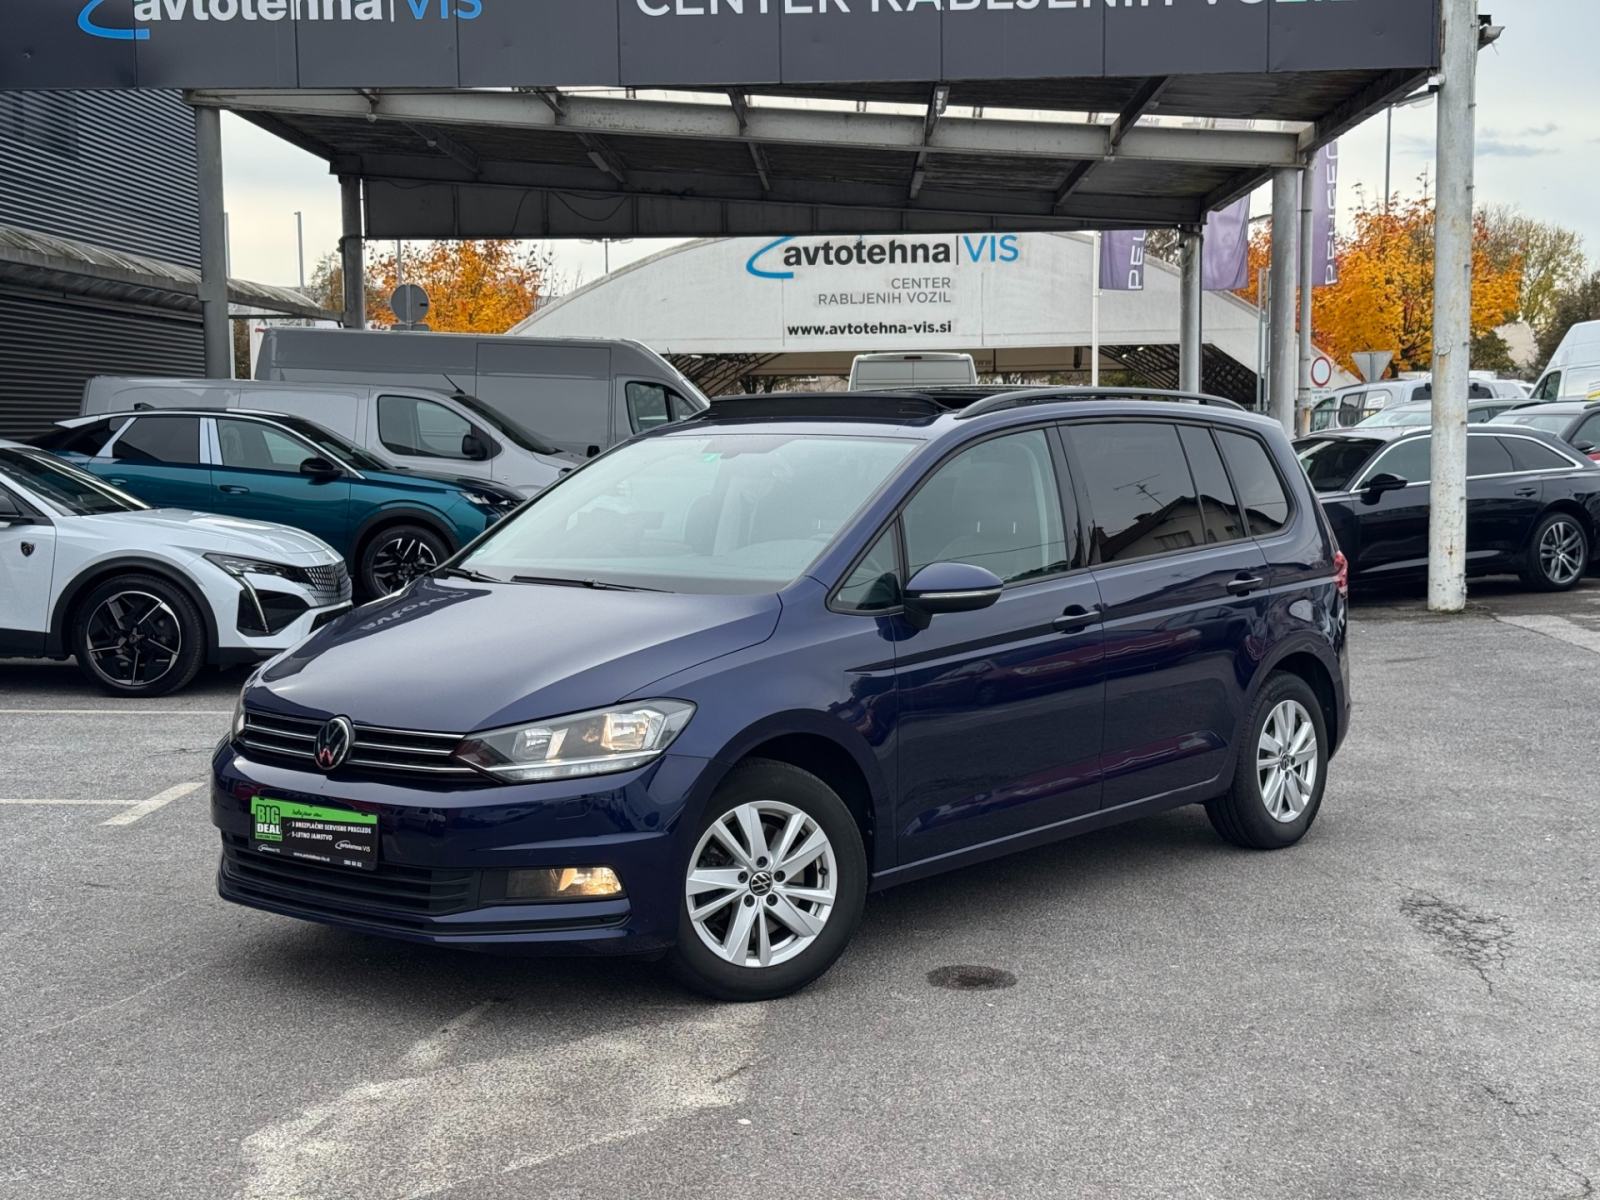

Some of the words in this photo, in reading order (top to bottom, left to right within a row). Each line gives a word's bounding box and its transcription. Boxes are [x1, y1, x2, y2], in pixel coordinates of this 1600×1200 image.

[783, 239, 951, 267] avtotehna
[963, 234, 1020, 262] VIS
[891, 276, 951, 290] CENTER
[818, 291, 902, 305] RABLJENIH
[907, 291, 952, 304] VOZIL
[787, 320, 952, 336] www.avtotehna-vis.si
[256, 805, 280, 825] BIG
[257, 823, 281, 835] DEAL
